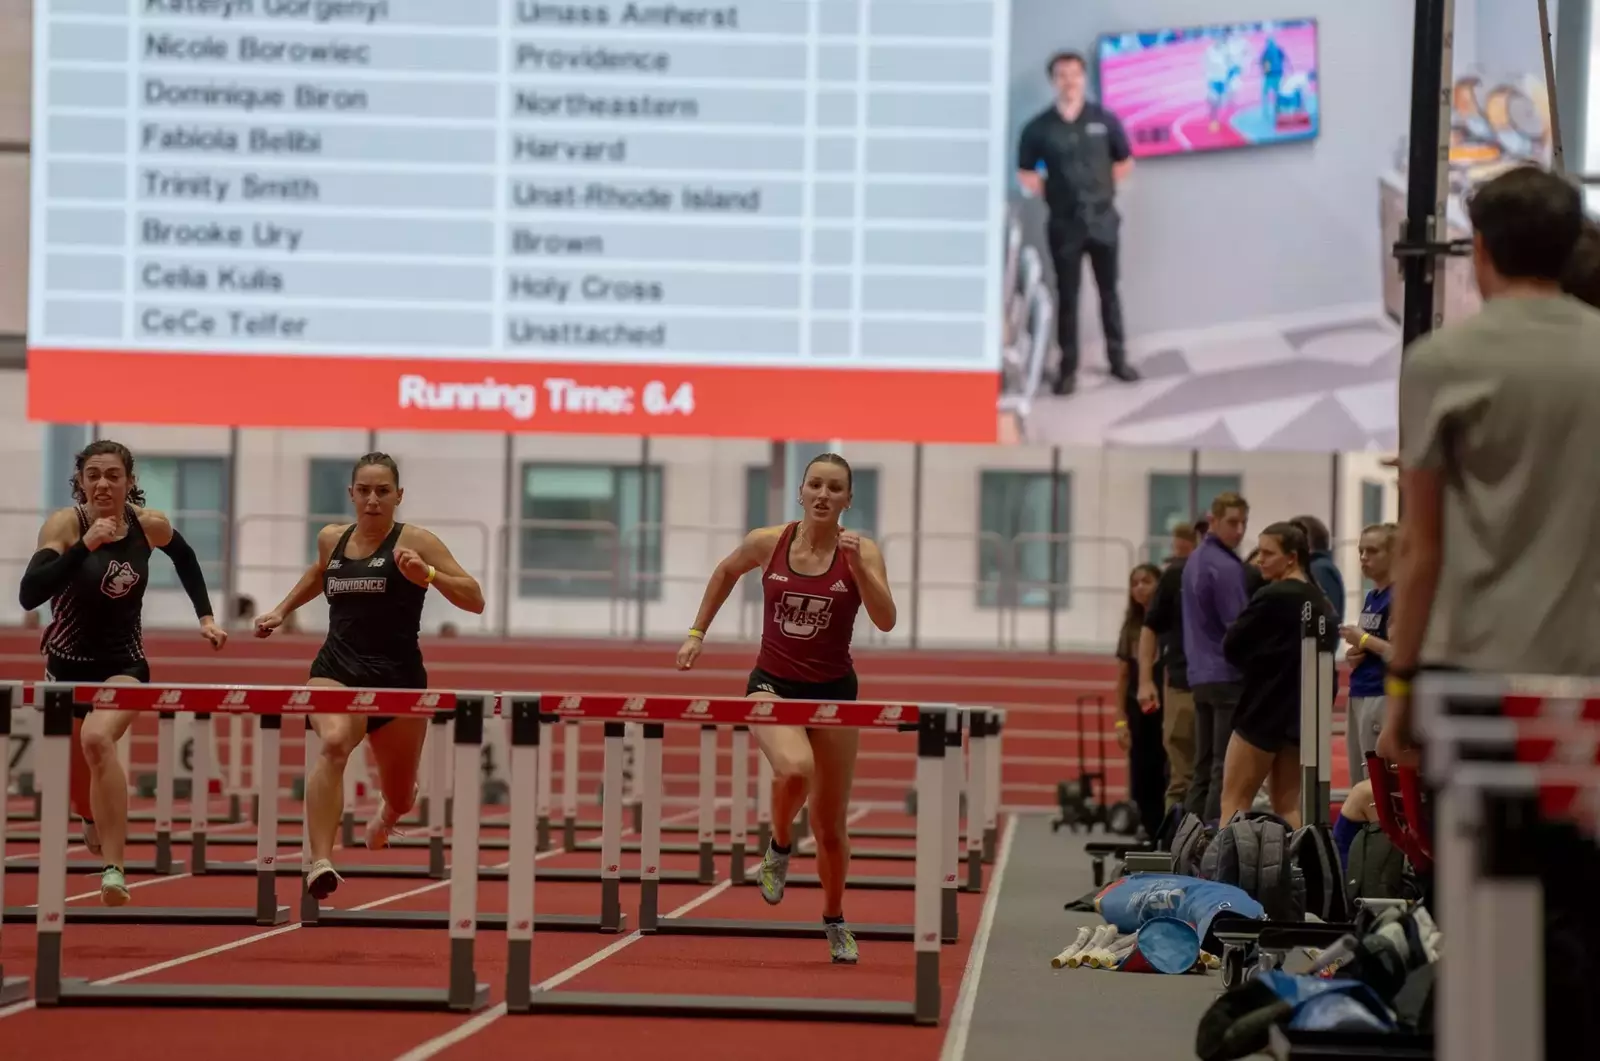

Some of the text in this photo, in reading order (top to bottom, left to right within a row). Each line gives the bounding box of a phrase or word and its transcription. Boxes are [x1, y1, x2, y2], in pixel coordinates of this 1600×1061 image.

[620, 3, 738, 28] Amherst
[145, 33, 370, 62] Nicole Borowiec
[515, 45, 670, 72] Providence
[144, 79, 368, 112] Dominique Biron
[515, 90, 699, 118] Northeastern
[142, 122, 239, 151] Fabiola
[513, 134, 626, 161] Harvard
[144, 169, 321, 203] Trinity Smith
[512, 182, 762, 214] Unat-Rhode Island
[141, 217, 302, 253] Brooke Ury
[511, 229, 604, 255] Brown
[509, 273, 665, 305] Holy Cross
[140, 308, 309, 336] CeCe Telfer
[508, 319, 667, 347] Unattached
[398, 375, 695, 420] Running Time: 6.4
